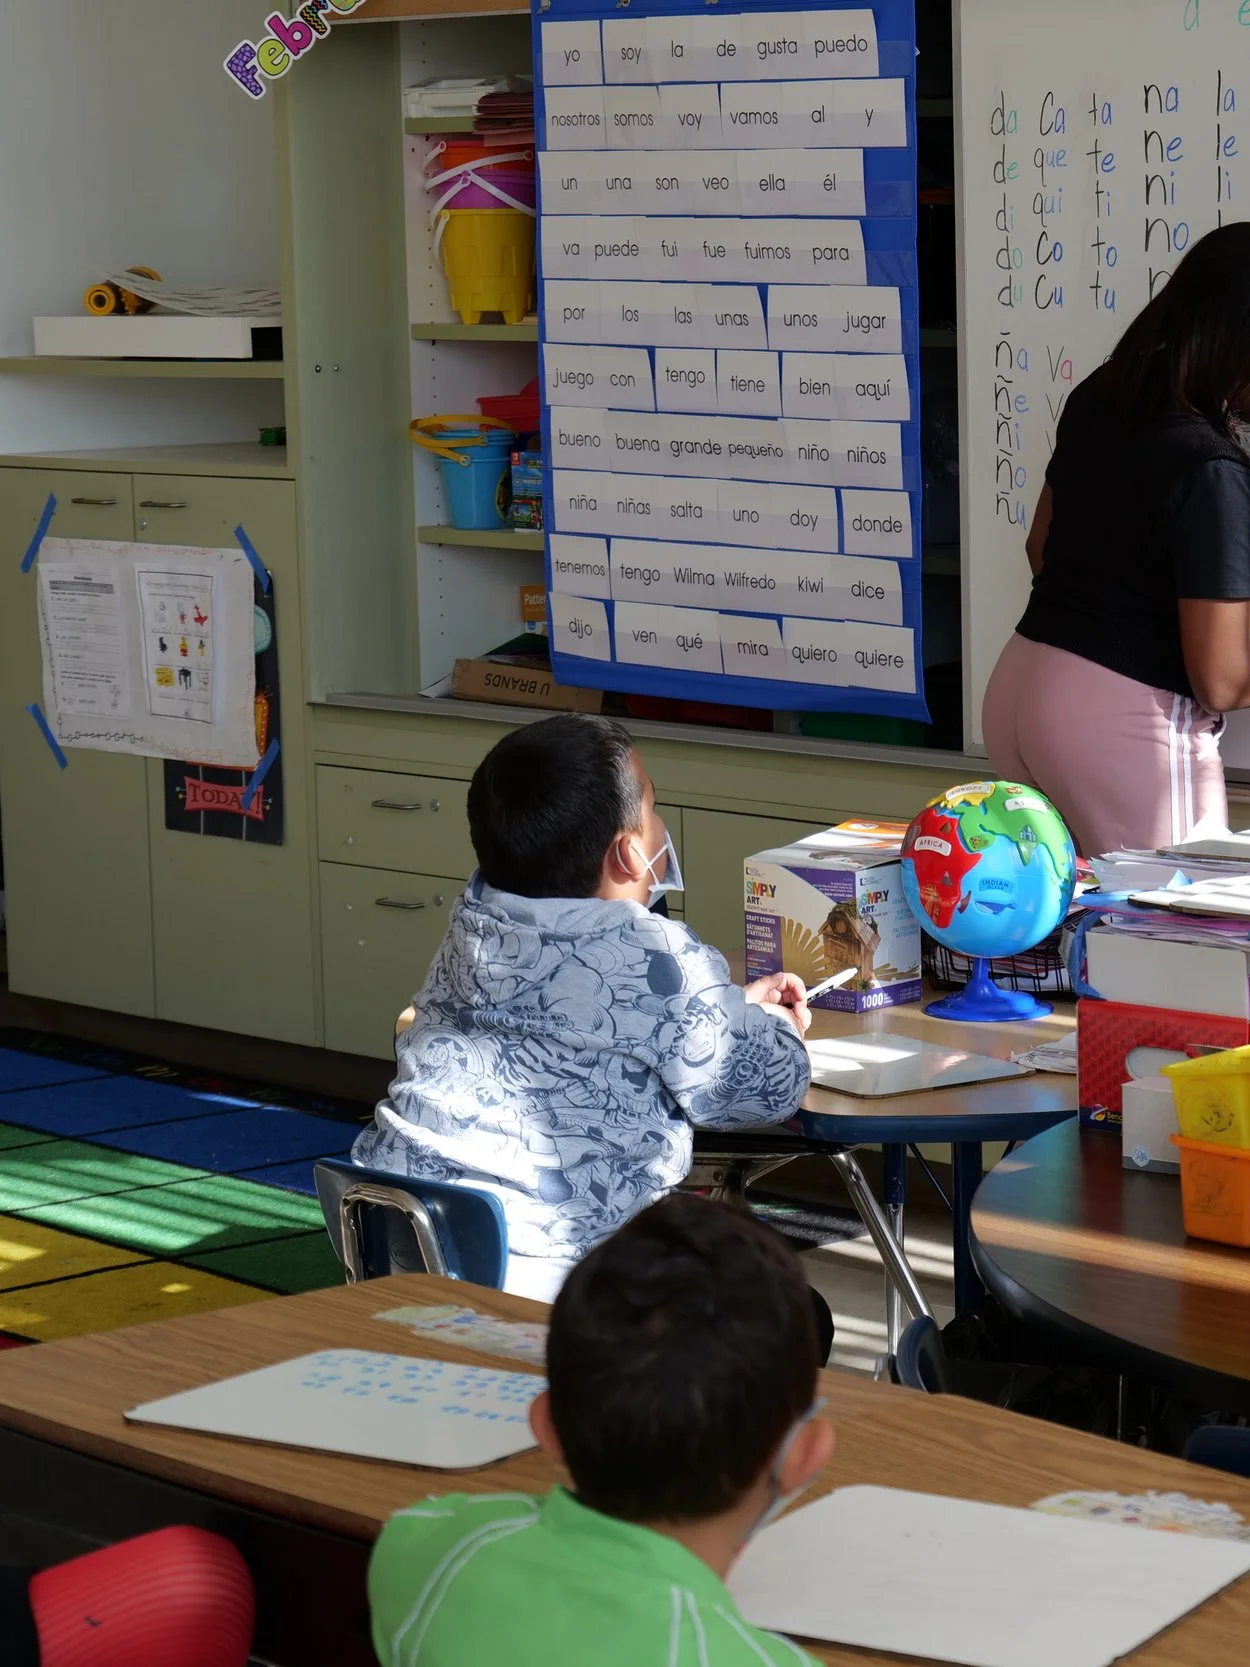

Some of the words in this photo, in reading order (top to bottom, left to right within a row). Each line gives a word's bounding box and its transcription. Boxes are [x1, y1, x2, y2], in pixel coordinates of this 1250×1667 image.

[564, 50, 580, 67] yo
[621, 48, 641, 64] soy
[672, 41, 683, 57] la
[717, 40, 736, 57] de
[757, 38, 797, 60] gusta
[815, 34, 867, 58] puedo
[552, 112, 600, 126] nosotros
[614, 114, 653, 126] somos
[678, 113, 702, 130] voy
[730, 112, 778, 124] vamos
[811, 105, 825, 123] al
[865, 109, 873, 127] y
[991, 91, 1016, 135] da
[1088, 93, 1111, 126] ta
[1144, 85, 1178, 113] na
[1217, 69, 1235, 116] la
[993, 144, 1016, 184] de
[1086, 139, 1115, 174] te
[1144, 130, 1183, 163] ne
[1216, 124, 1238, 160] le
[562, 178, 577, 190] un
[606, 177, 632, 190] una
[656, 178, 679, 190] son
[702, 177, 729, 190] veo
[759, 174, 785, 191] ella
[823, 174, 836, 191] él
[1095, 180, 1110, 218] ti
[1146, 171, 1174, 205] ni
[1218, 166, 1230, 202] li
[563, 244, 580, 255] va
[595, 240, 639, 261] puede
[661, 240, 678, 257] fui
[703, 241, 726, 258] fue
[745, 242, 791, 259] fuimos
[813, 247, 849, 264] para
[1091, 226, 1117, 267] to
[1145, 218, 1188, 252] no
[564, 308, 585, 324] por
[622, 305, 639, 322] los
[675, 306, 692, 324] las
[715, 314, 749, 326] unas
[784, 314, 817, 327] unos
[843, 312, 886, 334] jugar
[996, 332, 1028, 372] ña
[553, 368, 594, 389] juego
[610, 374, 635, 387] con
[666, 367, 705, 388] tengo
[731, 376, 765, 392] tiene
[800, 377, 830, 395] bien
[856, 379, 890, 400] aquí
[995, 375, 1029, 417] ñe
[559, 429, 600, 447] bueno
[616, 433, 660, 452] buena
[670, 439, 721, 457] grande
[728, 444, 783, 459] pequeño
[799, 444, 829, 461] niño
[848, 447, 886, 464] niños
[570, 495, 597, 511] niña
[617, 497, 650, 515] niñas
[671, 501, 702, 518] salta
[733, 509, 759, 523] uno
[790, 509, 818, 532] doy
[852, 514, 902, 533] donde
[555, 559, 605, 576] tenemos
[619, 564, 660, 586] tengo
[673, 568, 715, 586] Wilma
[724, 571, 776, 590] Wilfredo
[797, 576, 823, 593] kiwi
[851, 580, 884, 599] dice
[569, 618, 592, 639] dijo
[633, 630, 657, 643] ven
[675, 633, 702, 652] qué
[737, 640, 769, 656] mira
[792, 647, 837, 664] quiero
[855, 650, 904, 669] quiere
[484, 673, 537, 694] BRANDS
[919, 840, 943, 849] AFRICA
[983, 880, 1009, 888] INDIAN
[760, 916, 775, 924] STICKS
[862, 993, 883, 1009] 1000
